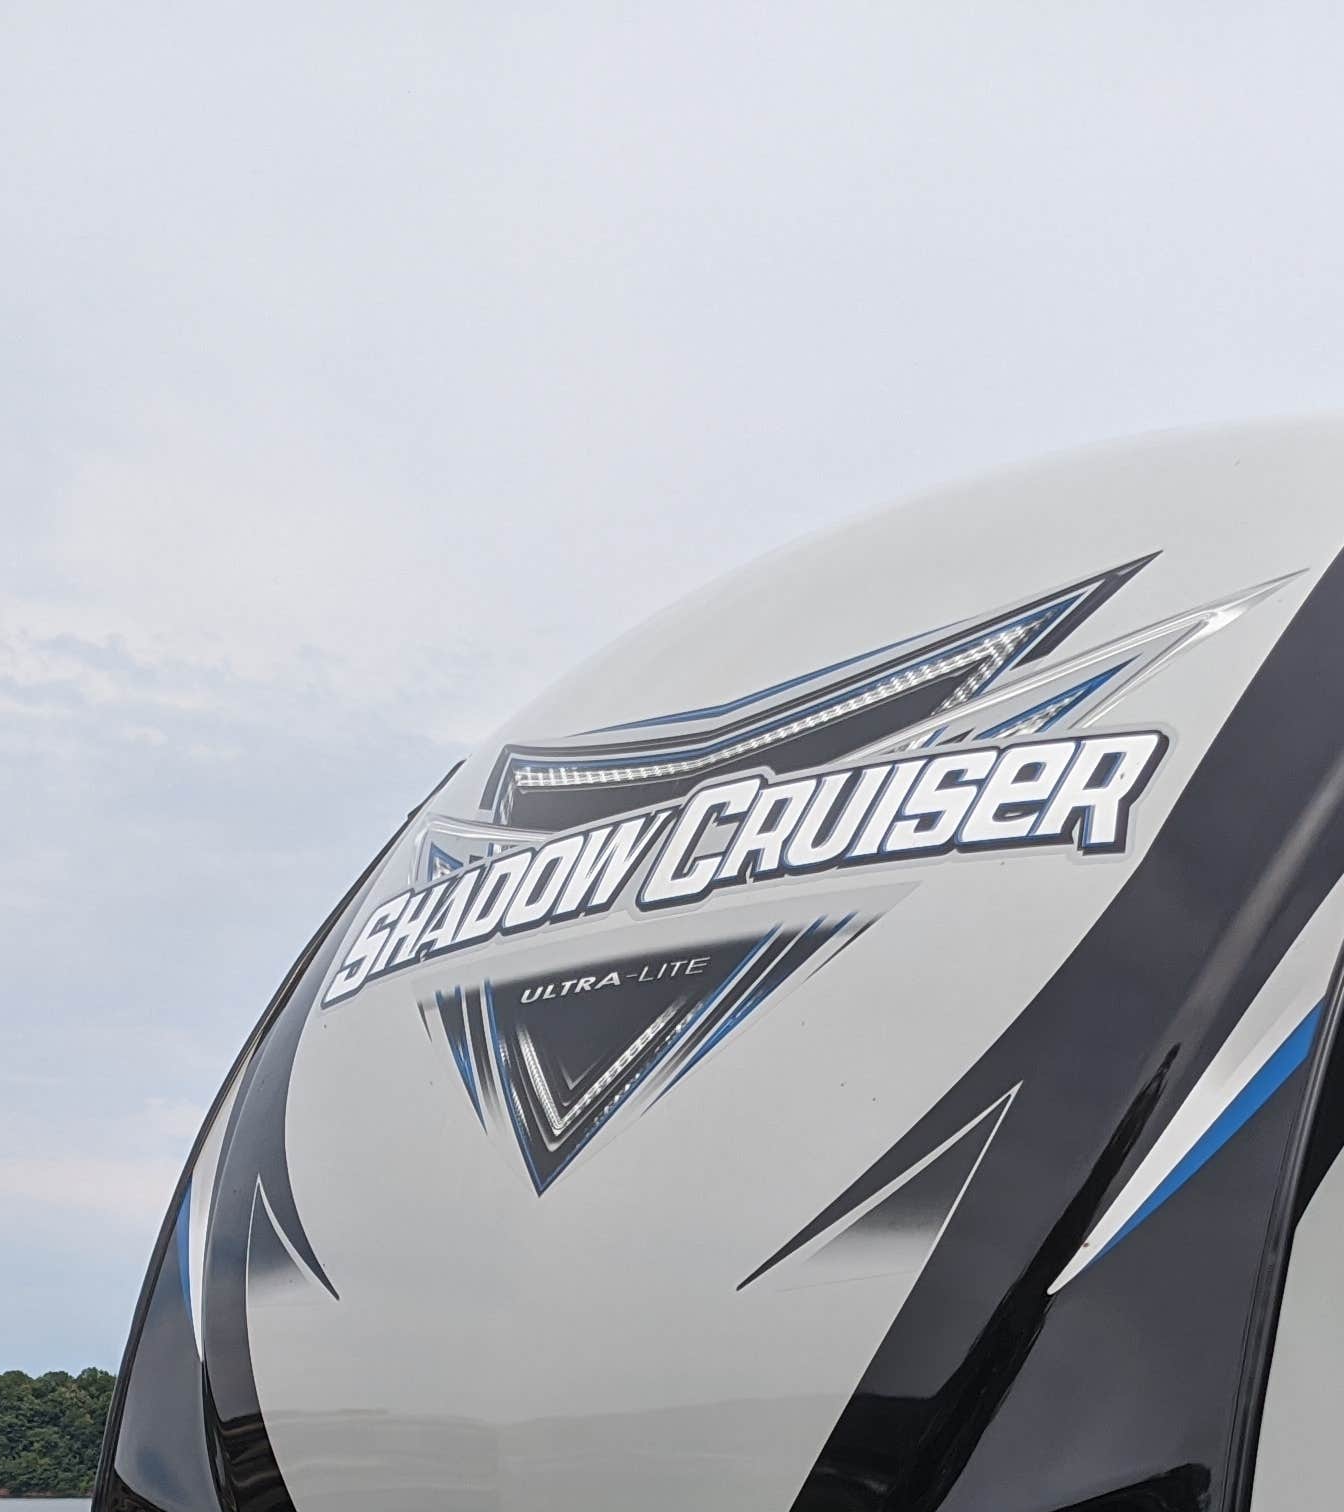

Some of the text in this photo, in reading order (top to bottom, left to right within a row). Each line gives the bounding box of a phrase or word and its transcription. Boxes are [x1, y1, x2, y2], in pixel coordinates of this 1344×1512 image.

[320, 729, 1169, 1008] SHADOW CRUISER
[520, 956, 711, 1004] ULTRA-LITE
